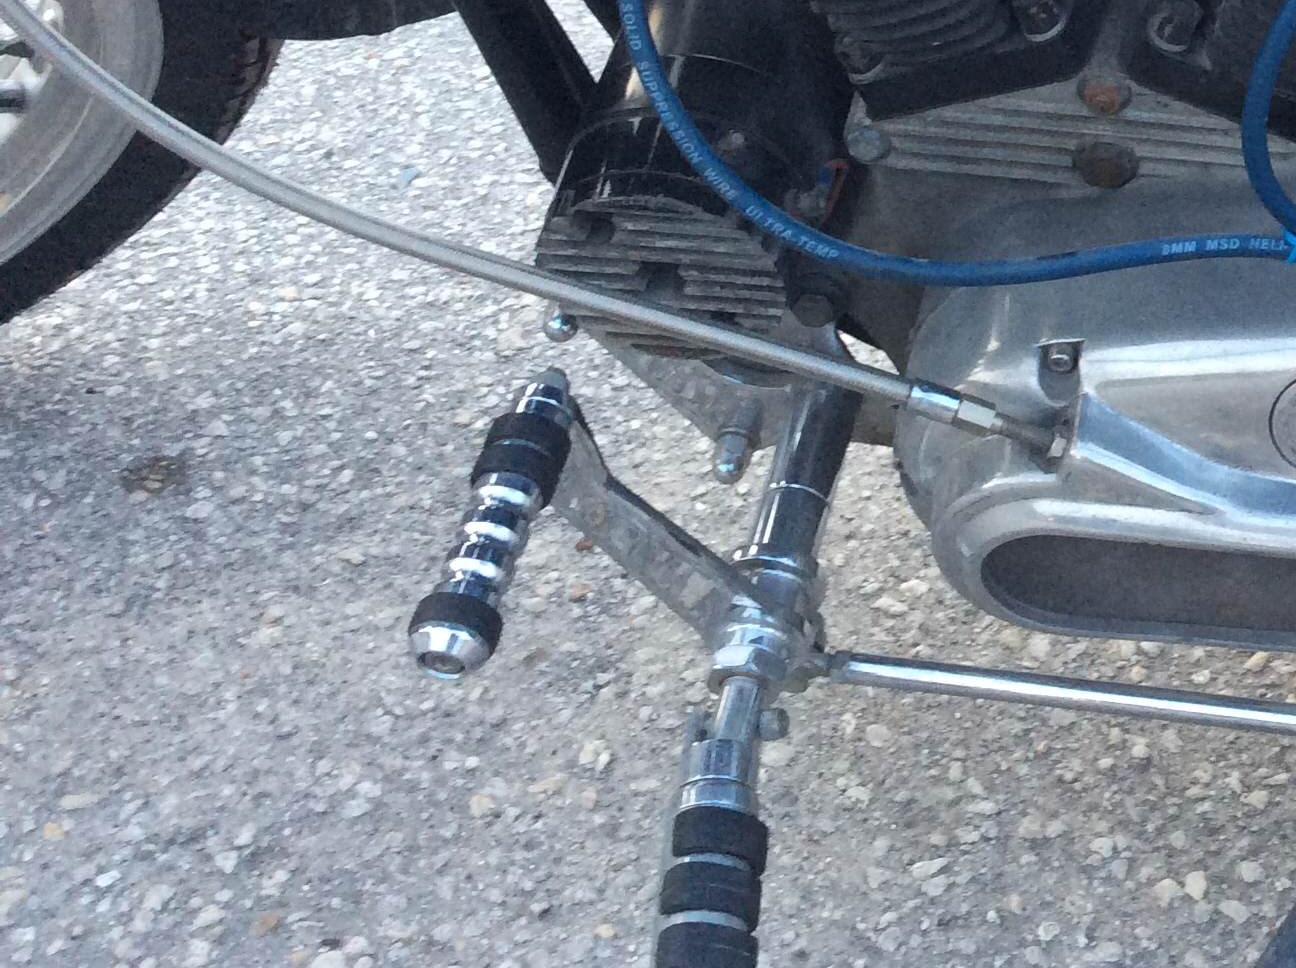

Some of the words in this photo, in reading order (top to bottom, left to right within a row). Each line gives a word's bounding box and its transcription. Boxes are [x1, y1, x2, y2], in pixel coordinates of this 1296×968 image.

[622, 2, 642, 51] SOLID
[639, 61, 703, 164] SUPPRESSION
[703, 168, 737, 200] WIRE
[1205, 238, 1240, 251] MSD
